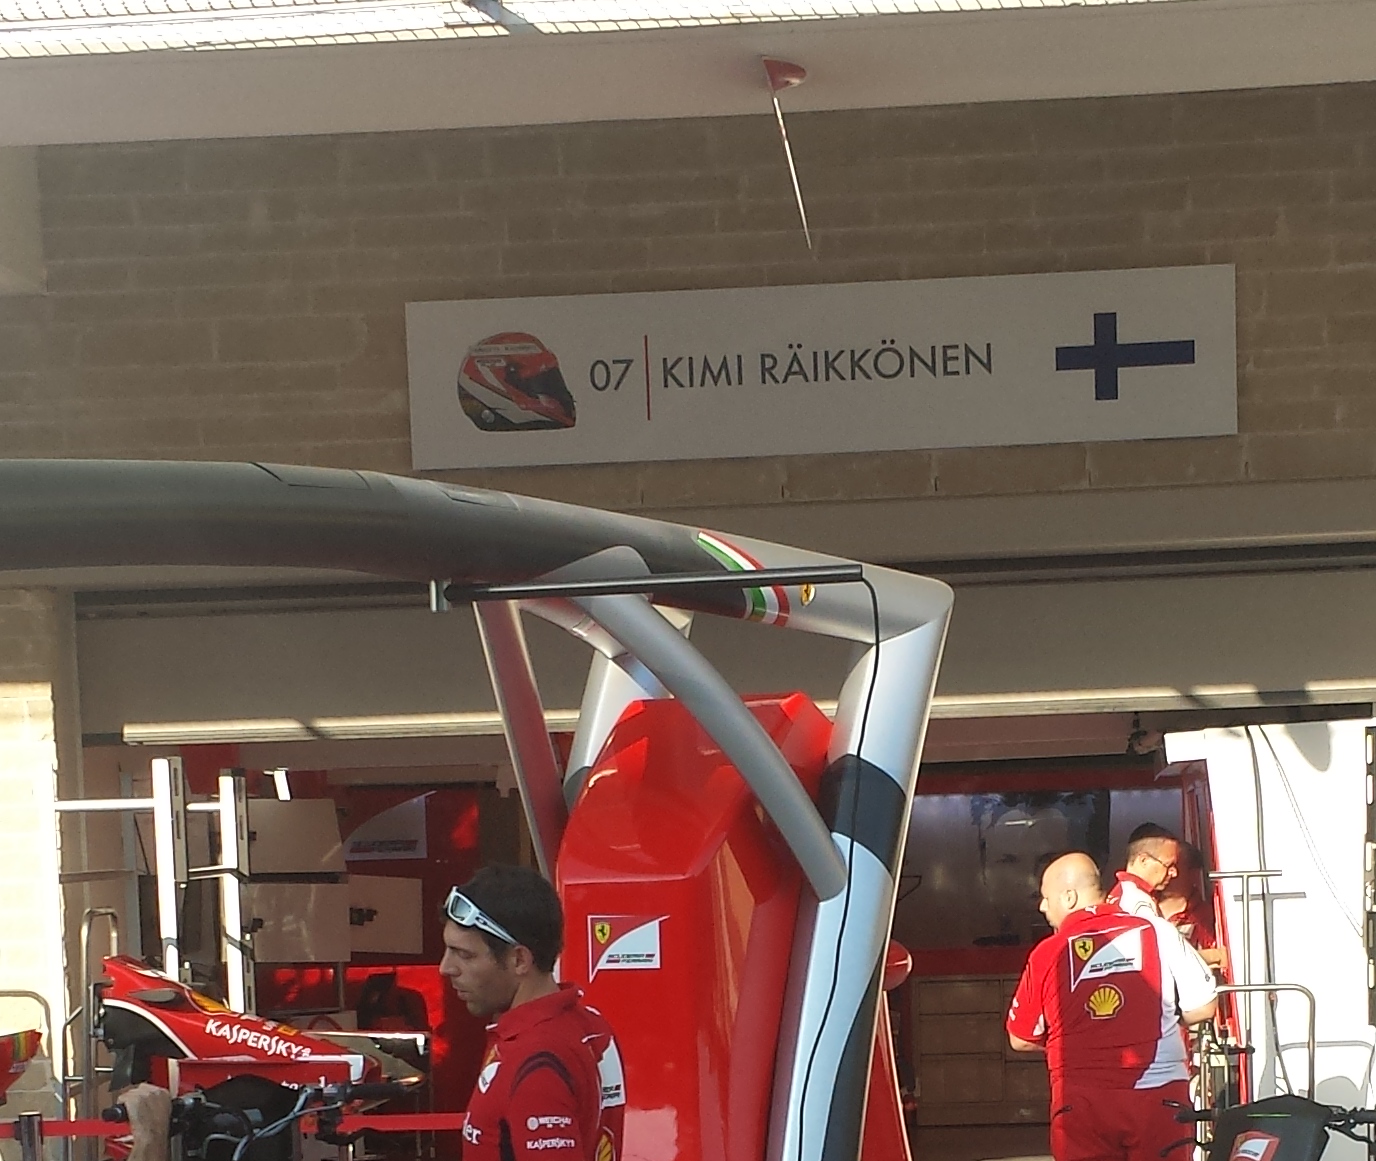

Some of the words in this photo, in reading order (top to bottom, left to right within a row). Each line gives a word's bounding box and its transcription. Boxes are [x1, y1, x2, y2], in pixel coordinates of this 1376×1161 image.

[589, 358, 634, 392] 07
[662, 354, 743, 389] KIMI
[759, 338, 993, 385] RÄIKKÖNEN
[204, 1018, 304, 1060] KASPERSKY
